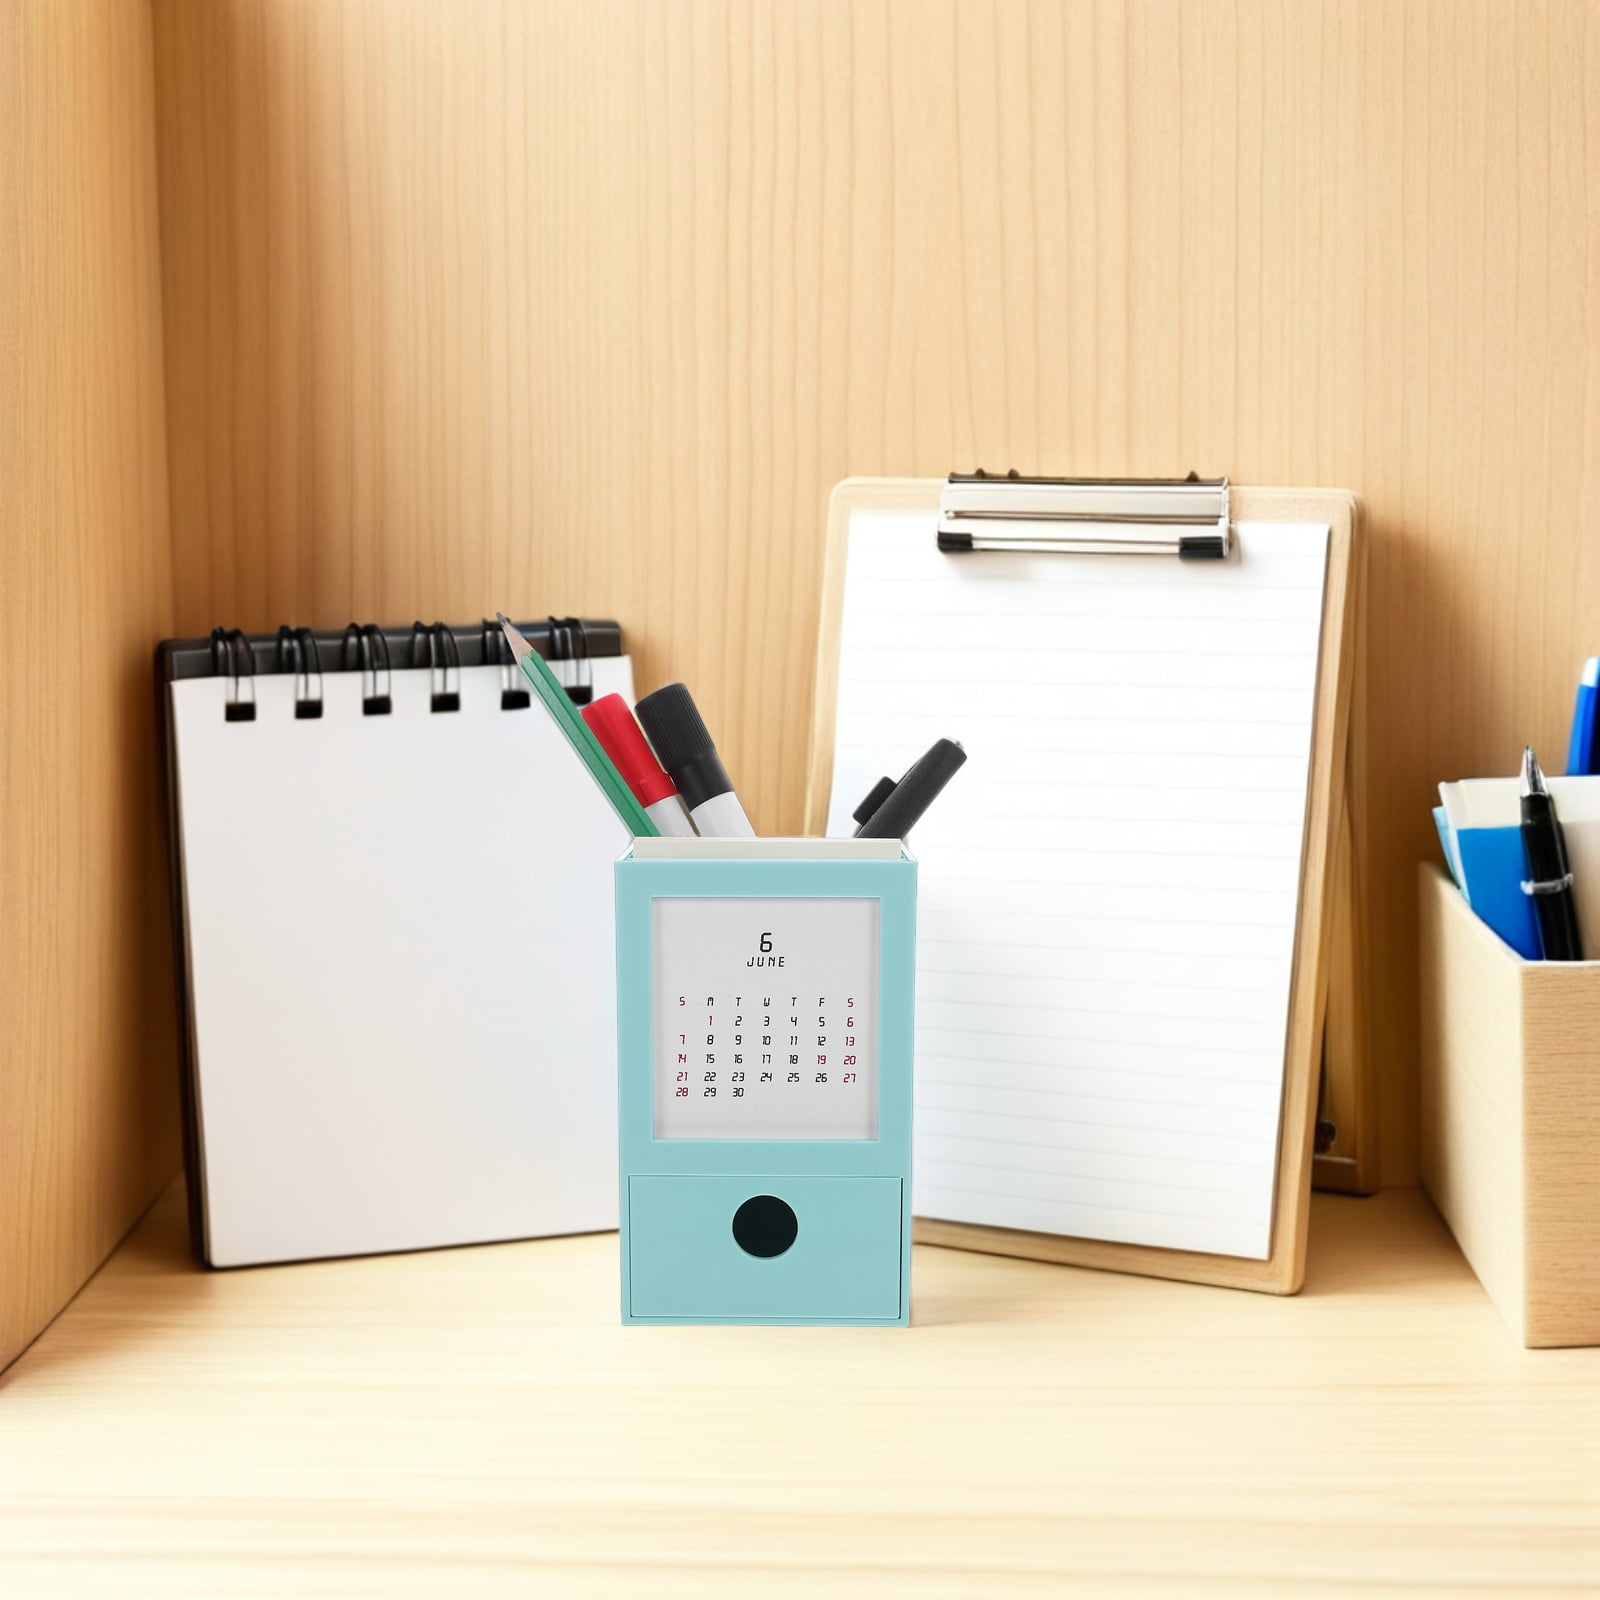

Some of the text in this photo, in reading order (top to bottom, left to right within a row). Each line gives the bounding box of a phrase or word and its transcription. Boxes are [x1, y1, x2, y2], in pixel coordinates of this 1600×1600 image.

[759, 931, 773, 953] 6
[746, 956, 785, 968] JUNE
[679, 995, 686, 1007] S
[735, 996, 742, 1007] T
[791, 996, 798, 1007] T
[818, 997, 826, 1008] F
[847, 997, 854, 1008] S
[708, 1015, 854, 1028] 1 2 3 4 5 6
[679, 1034, 856, 1047] 7 8 9 10 11 12 13
[677, 1053, 857, 1066] 14 15 16 17 18 19 20
[676, 1071, 857, 1084] 21 22 23 24 25 26 27
[675, 1086, 745, 1098] 28 29 30
